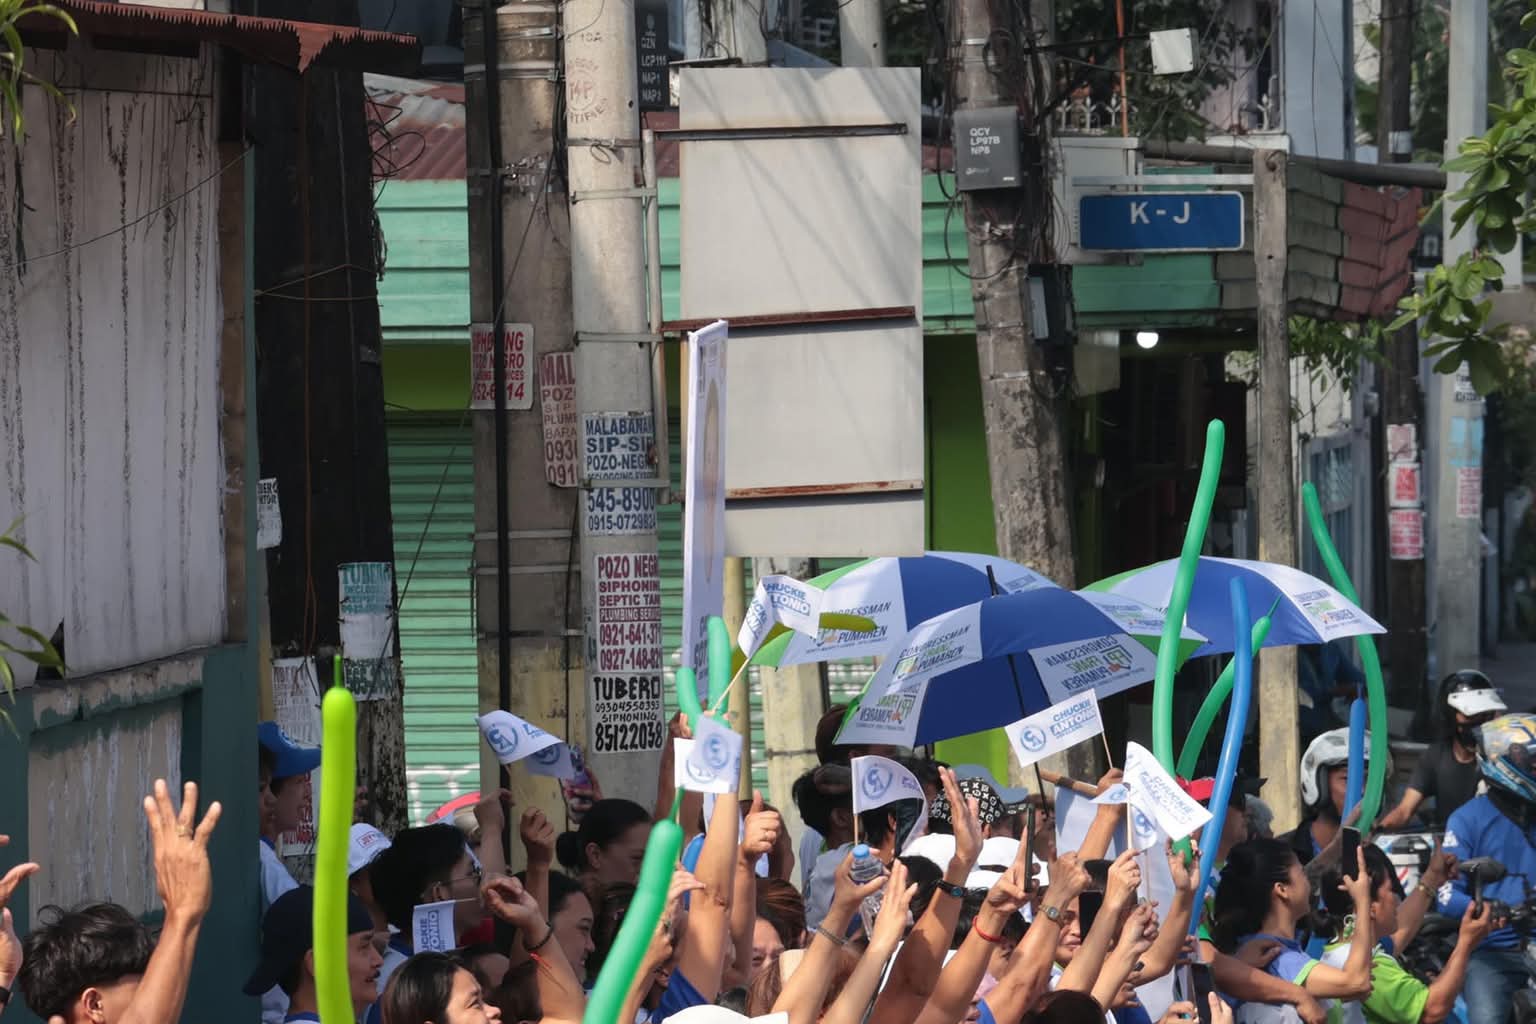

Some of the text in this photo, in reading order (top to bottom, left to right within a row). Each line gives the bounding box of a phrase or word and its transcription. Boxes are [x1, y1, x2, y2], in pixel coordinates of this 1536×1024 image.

[598, 554, 630, 579] POZO
[599, 594, 641, 607] SEPTIC
[593, 675, 661, 701] TUBERO
[602, 711, 657, 723] SIPHONING
